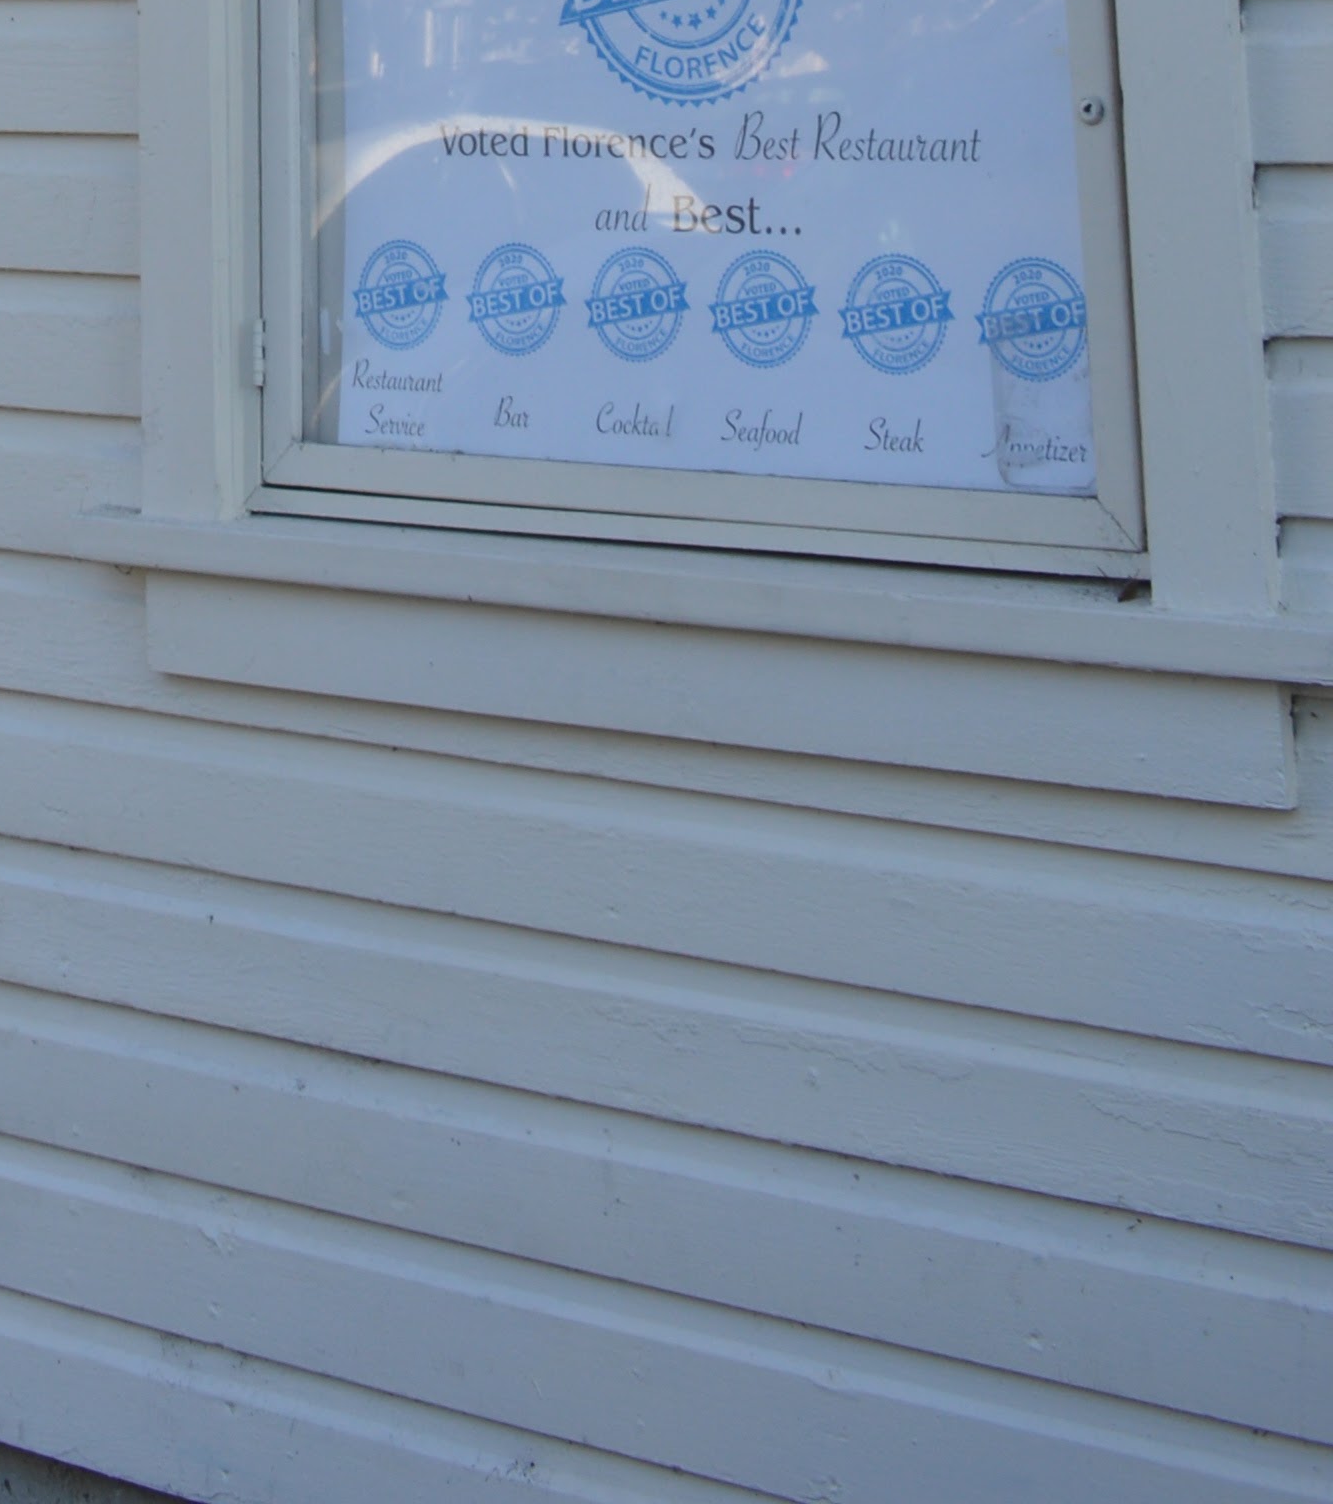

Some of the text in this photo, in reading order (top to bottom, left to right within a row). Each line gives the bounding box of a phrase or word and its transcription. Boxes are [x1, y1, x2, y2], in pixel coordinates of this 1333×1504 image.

[634, 13, 768, 80] FLORENCE
[440, 110, 982, 163] Voted Florence's Best Restaurant
[595, 183, 803, 236] and Best...
[358, 277, 440, 313] BEST OF
[383, 270, 413, 284] VOTED
[498, 273, 529, 287] VOTED
[618, 277, 651, 292] VOTED
[744, 282, 777, 297] VOTED
[877, 286, 910, 302] VOTED
[472, 281, 558, 318] BEST OF
[591, 286, 681, 323] BEST OF
[715, 290, 810, 329] BEST OF
[845, 295, 944, 334] BEST OF
[1013, 291, 1049, 307] VOTED
[983, 300, 1086, 340] BEST OF
[352, 358, 443, 394] Restaurant
[365, 403, 426, 437] Service
[493, 394, 531, 429] Bar
[596, 401, 675, 437] Cocktal
[721, 409, 803, 452] Seafood
[864, 416, 925, 453] Steak
